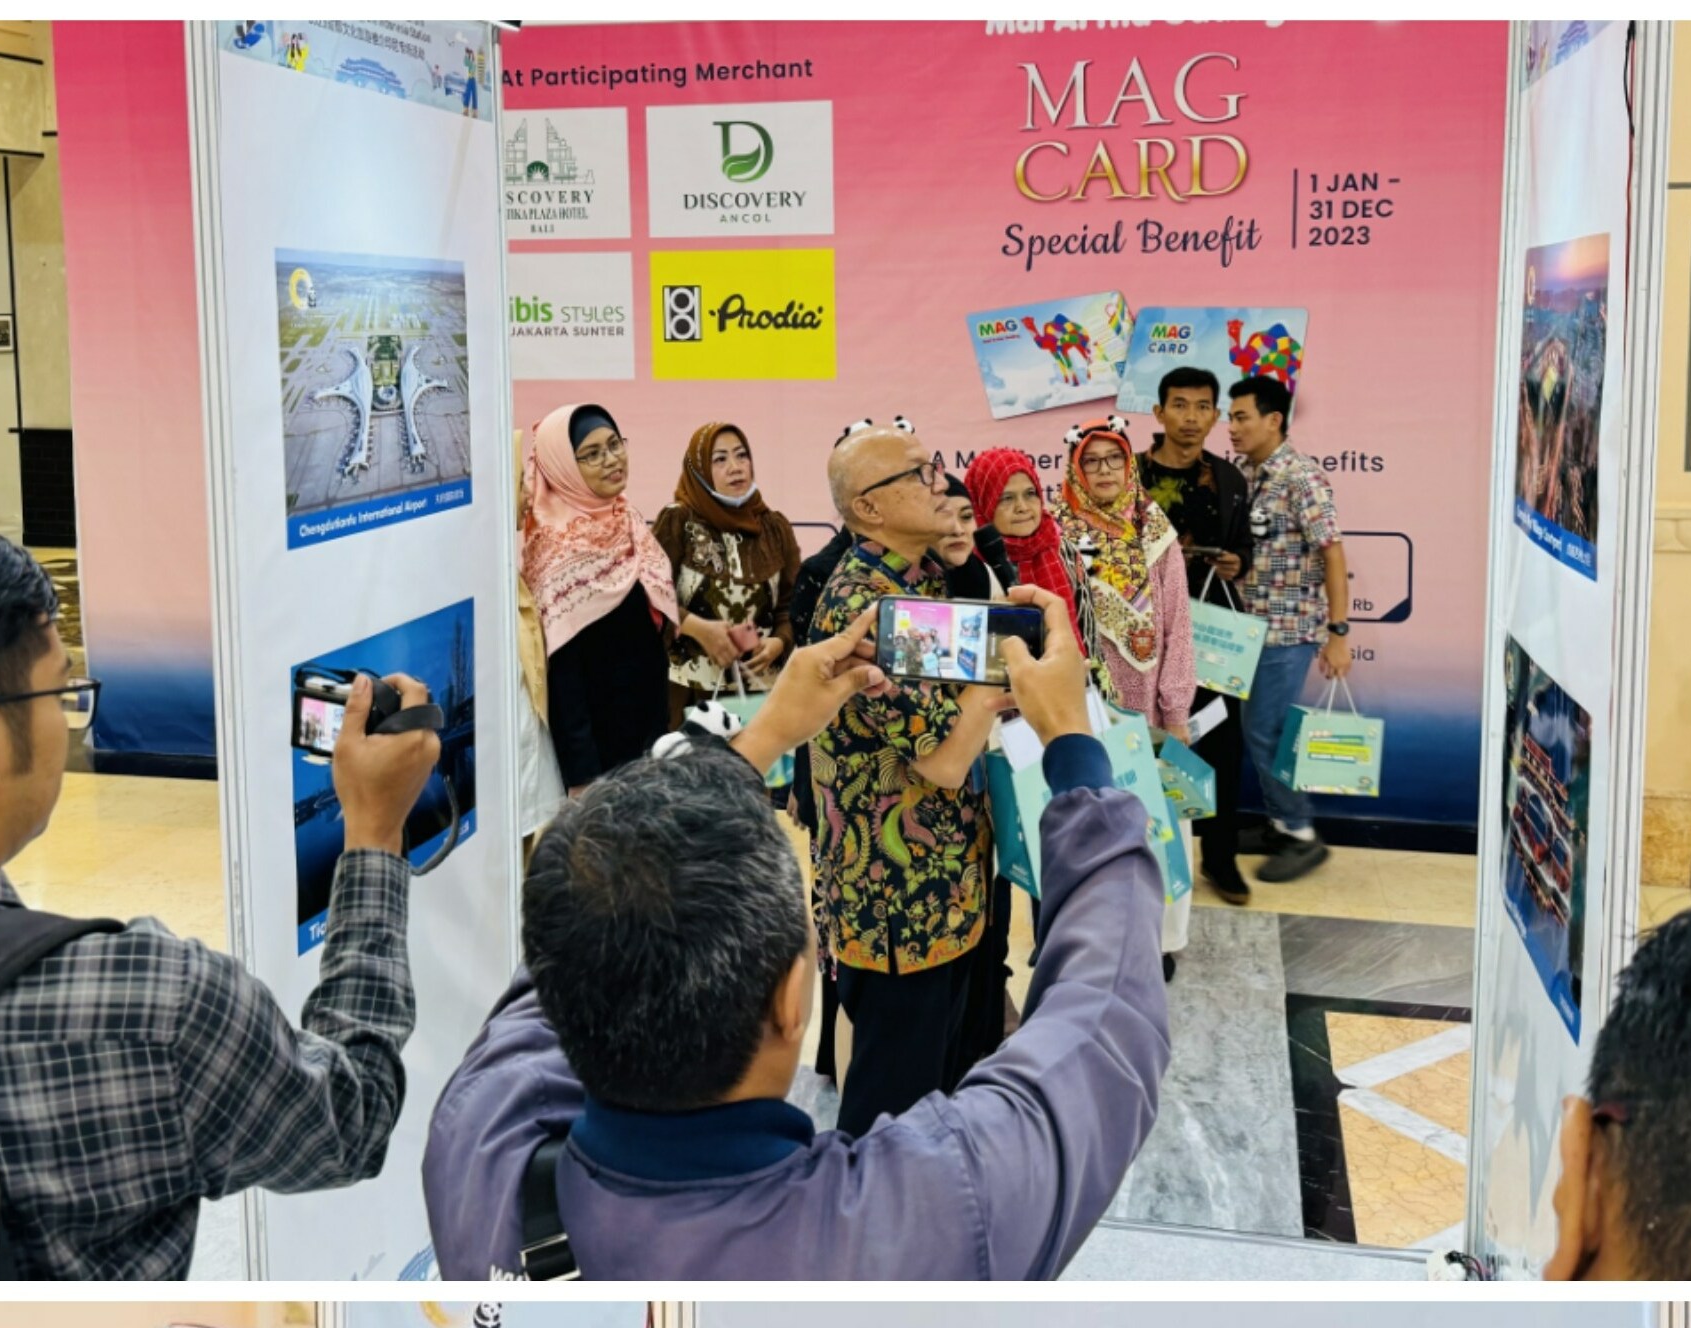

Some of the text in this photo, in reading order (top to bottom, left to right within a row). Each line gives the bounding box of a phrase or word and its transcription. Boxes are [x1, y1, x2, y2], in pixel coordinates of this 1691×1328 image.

[532, 63, 687, 90] Participating
[696, 58, 813, 81] Merchant
[1017, 52, 1248, 131] MAG
[1013, 134, 1249, 204] CARD
[1310, 174, 1320, 194] 1
[1326, 173, 1378, 193] JAN
[682, 190, 808, 210] DISCOVERY
[1308, 199, 1394, 220] 31 DEC
[720, 213, 772, 224] ANCOL
[1001, 215, 1262, 272] Special Benefit
[1308, 226, 1371, 247] 2023
[510, 326, 625, 338] JAKARTA SUNTER
[978, 320, 1018, 337] MAG
[1151, 324, 1192, 340] MAG
[1148, 342, 1189, 355] CARD
